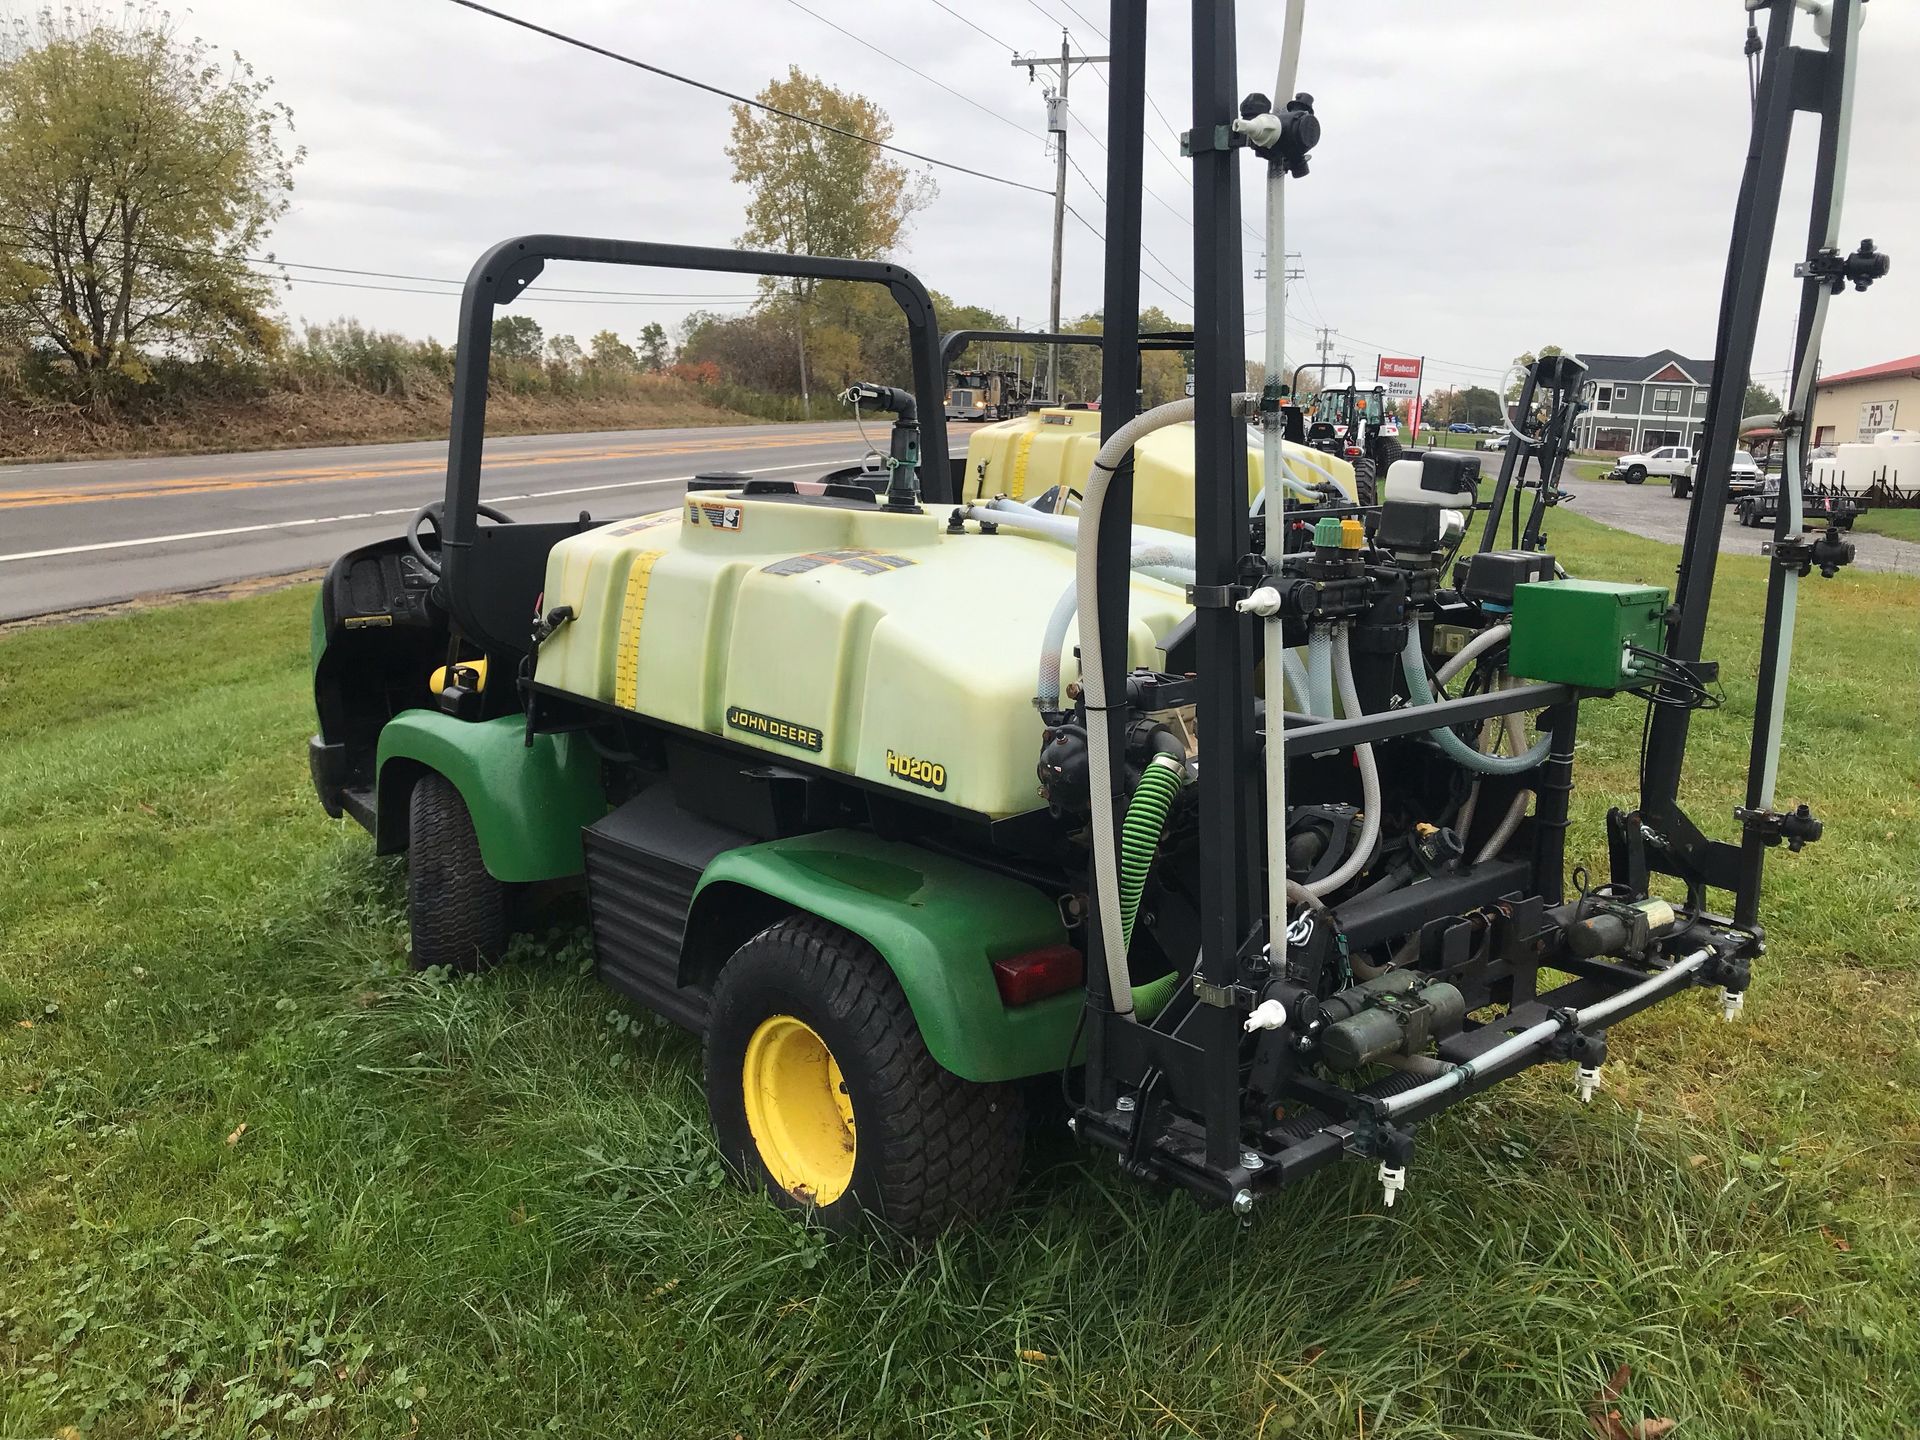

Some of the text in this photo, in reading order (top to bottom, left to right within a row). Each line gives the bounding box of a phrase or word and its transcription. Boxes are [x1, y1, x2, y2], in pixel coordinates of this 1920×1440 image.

[1388, 387, 1413, 395] Service
[731, 711, 817, 746] JOHN DEERE
[887, 750, 947, 790] HD200
